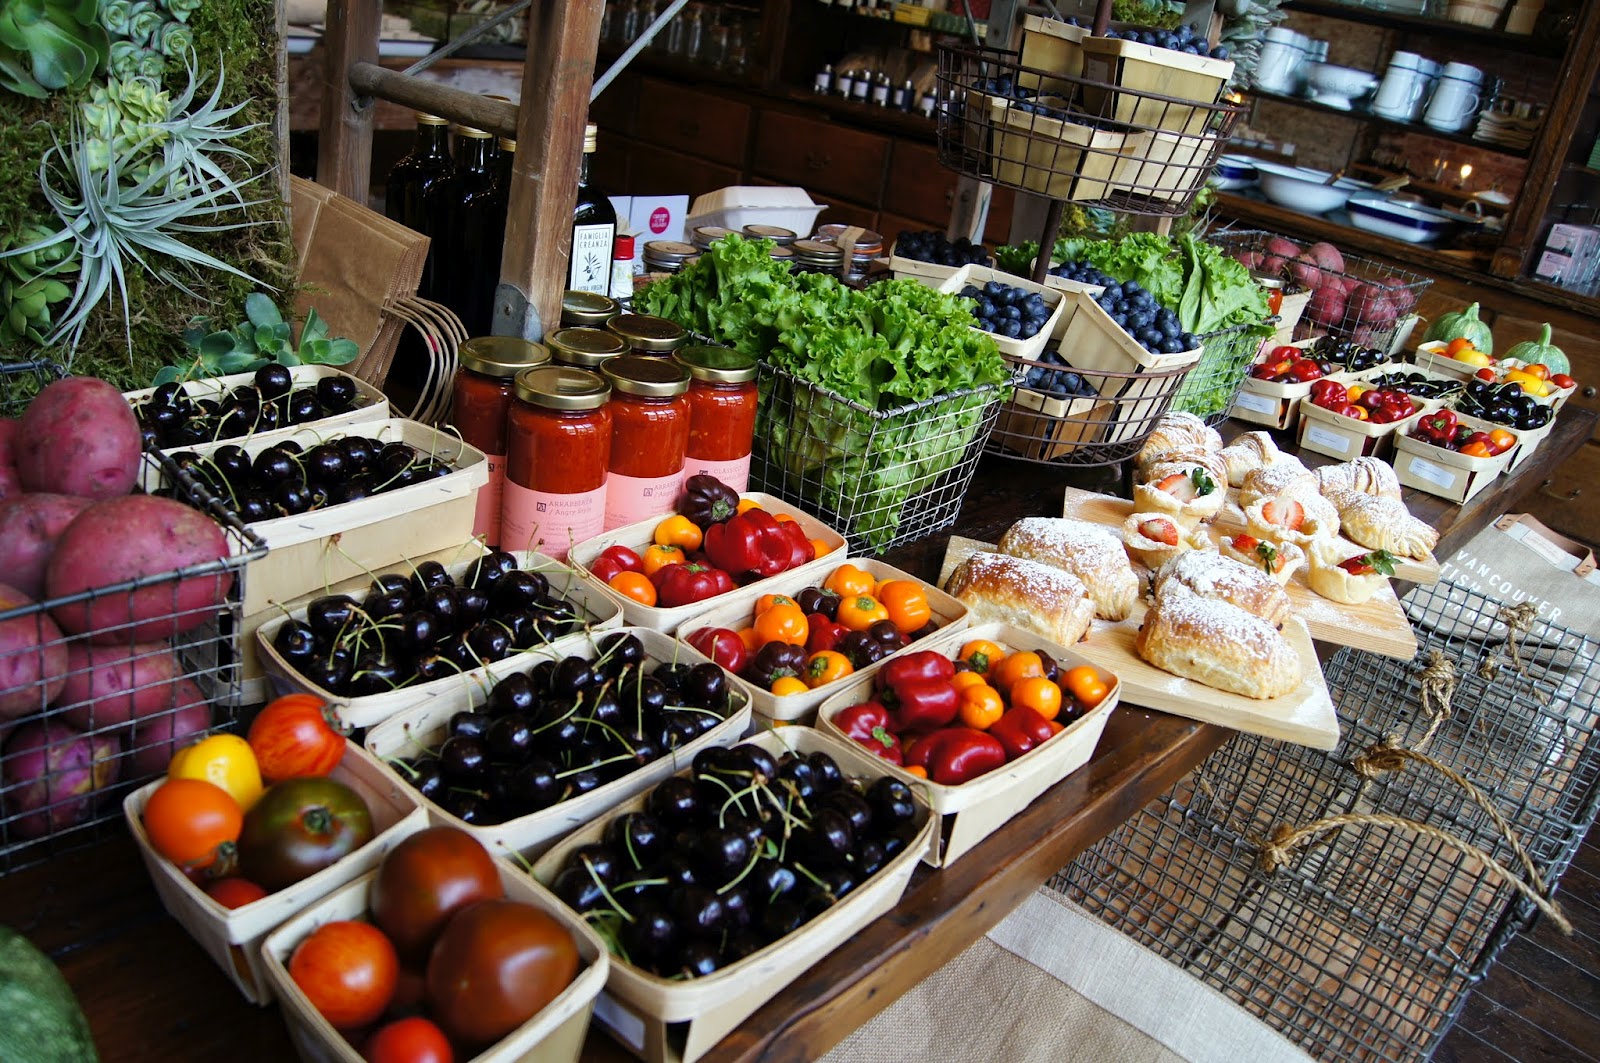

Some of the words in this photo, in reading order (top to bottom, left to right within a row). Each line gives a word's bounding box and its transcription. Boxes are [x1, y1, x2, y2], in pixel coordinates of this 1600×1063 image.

[580, 232, 608, 240] FAMIGLIA
[580, 240, 608, 248] CREANZA
[549, 498, 593, 508] ARRABBIATA
[554, 509, 576, 517] Angry
[1456, 550, 1562, 623] VANCOUVER
